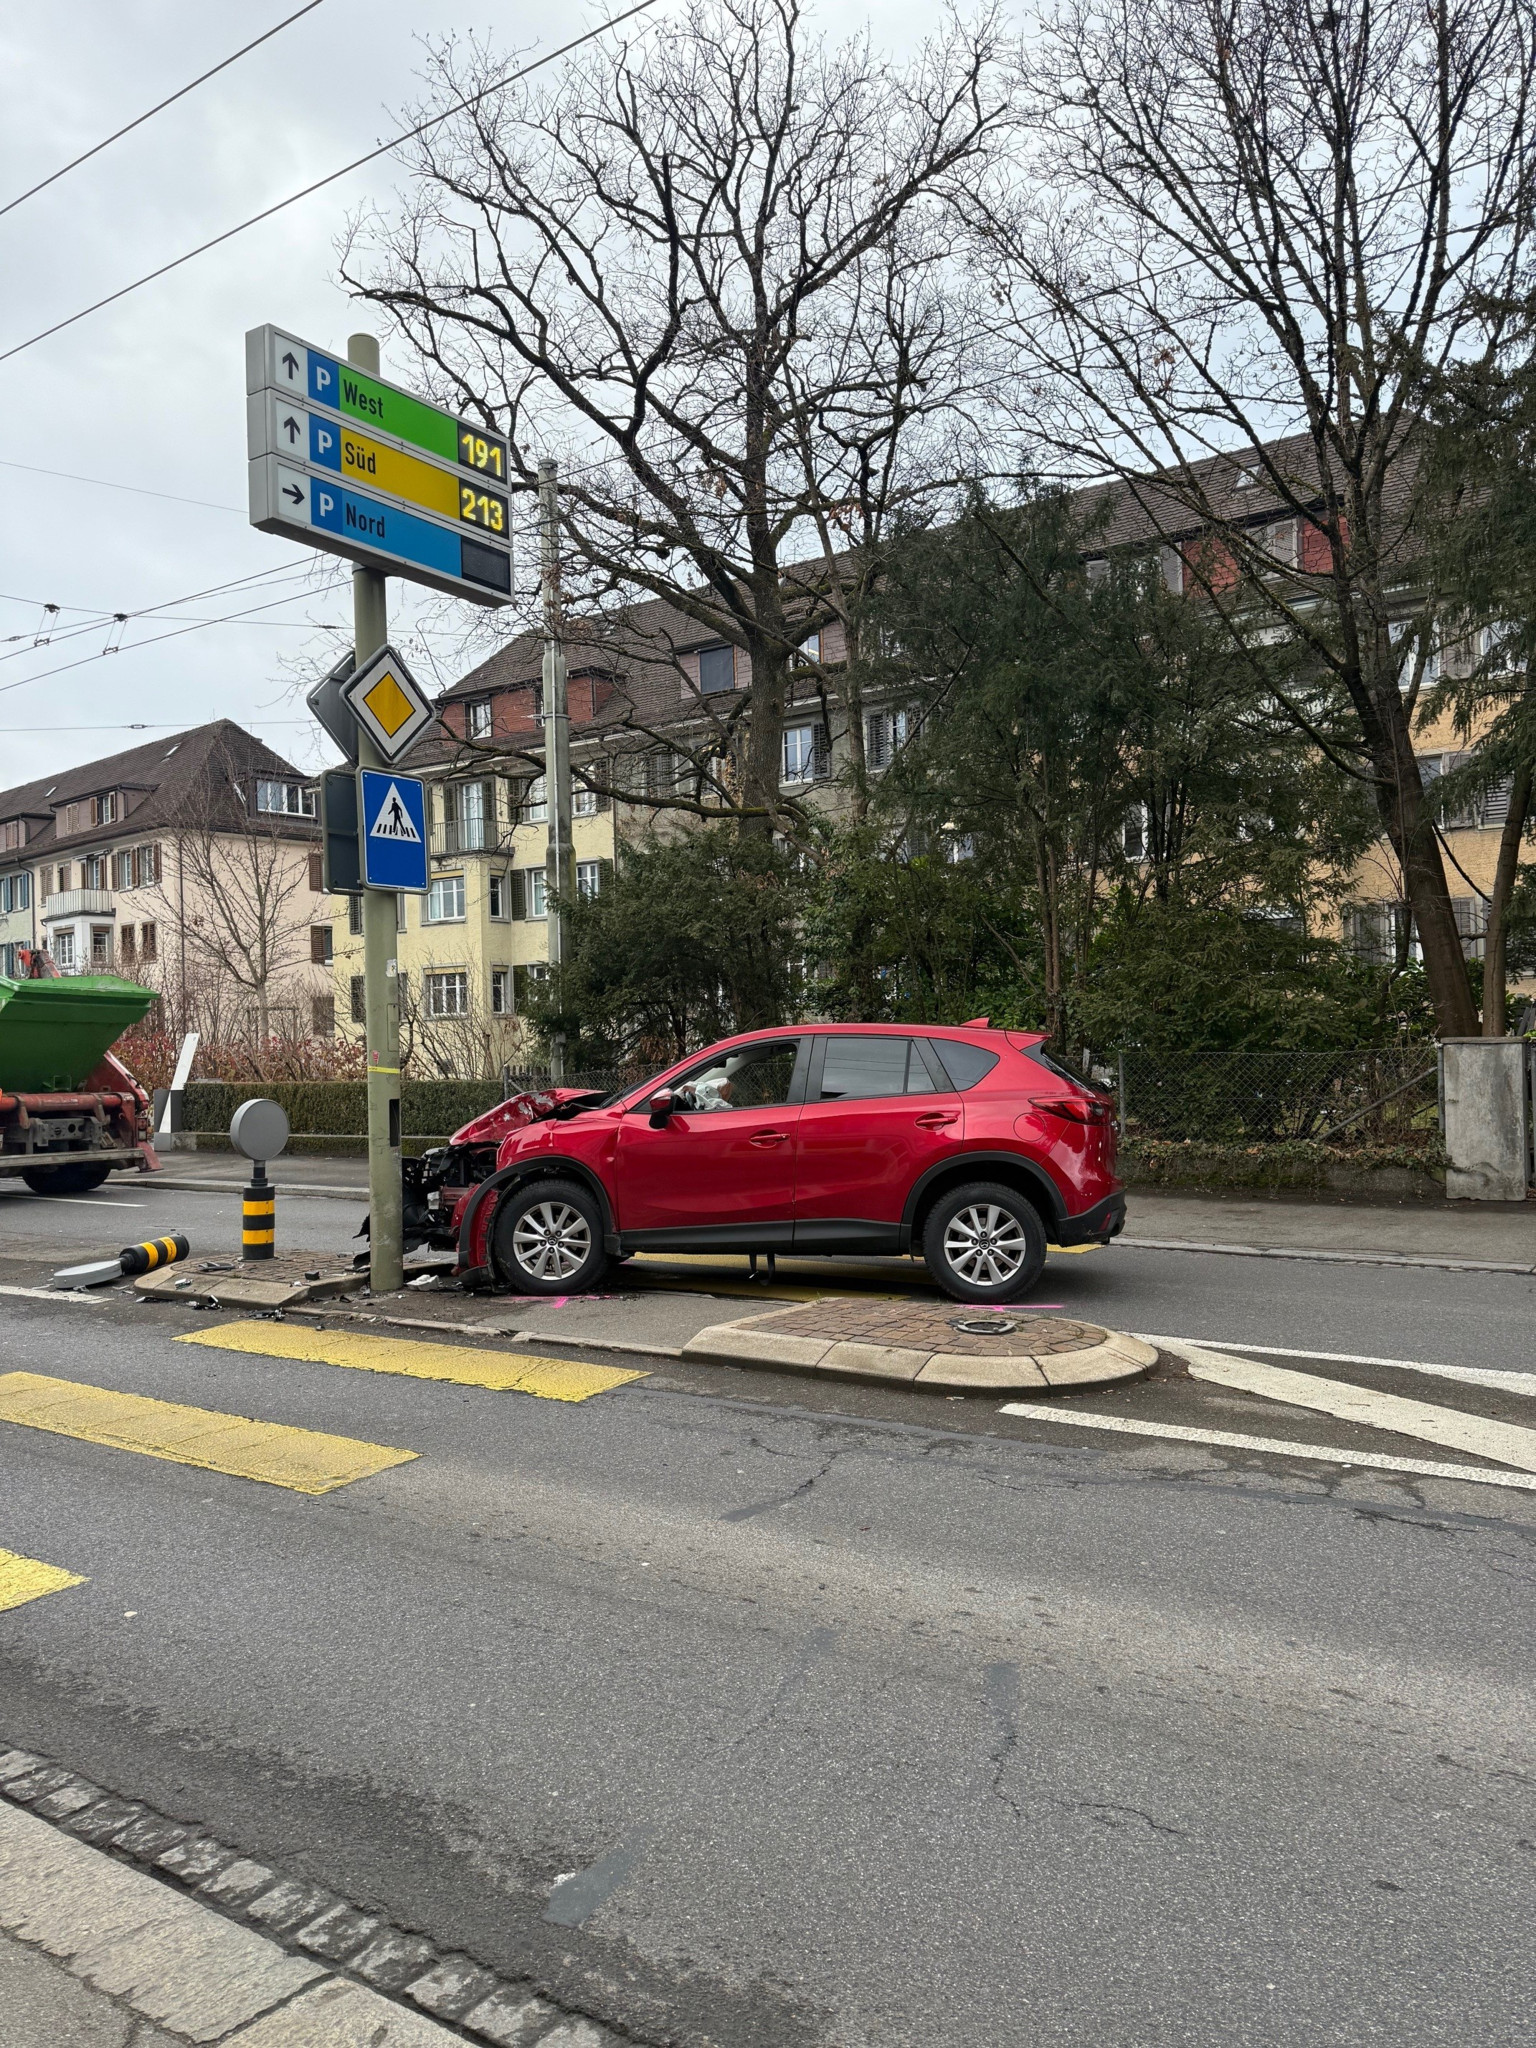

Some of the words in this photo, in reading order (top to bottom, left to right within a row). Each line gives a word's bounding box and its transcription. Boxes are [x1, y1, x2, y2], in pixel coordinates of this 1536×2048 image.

[316, 366, 331, 391] P
[343, 379, 384, 419] West
[462, 434, 502, 477] 191
[318, 429, 333, 454] P
[344, 442, 377, 475] Süd
[462, 488, 504, 531] 213
[319, 492, 334, 517] P
[346, 503, 386, 539] Nord
